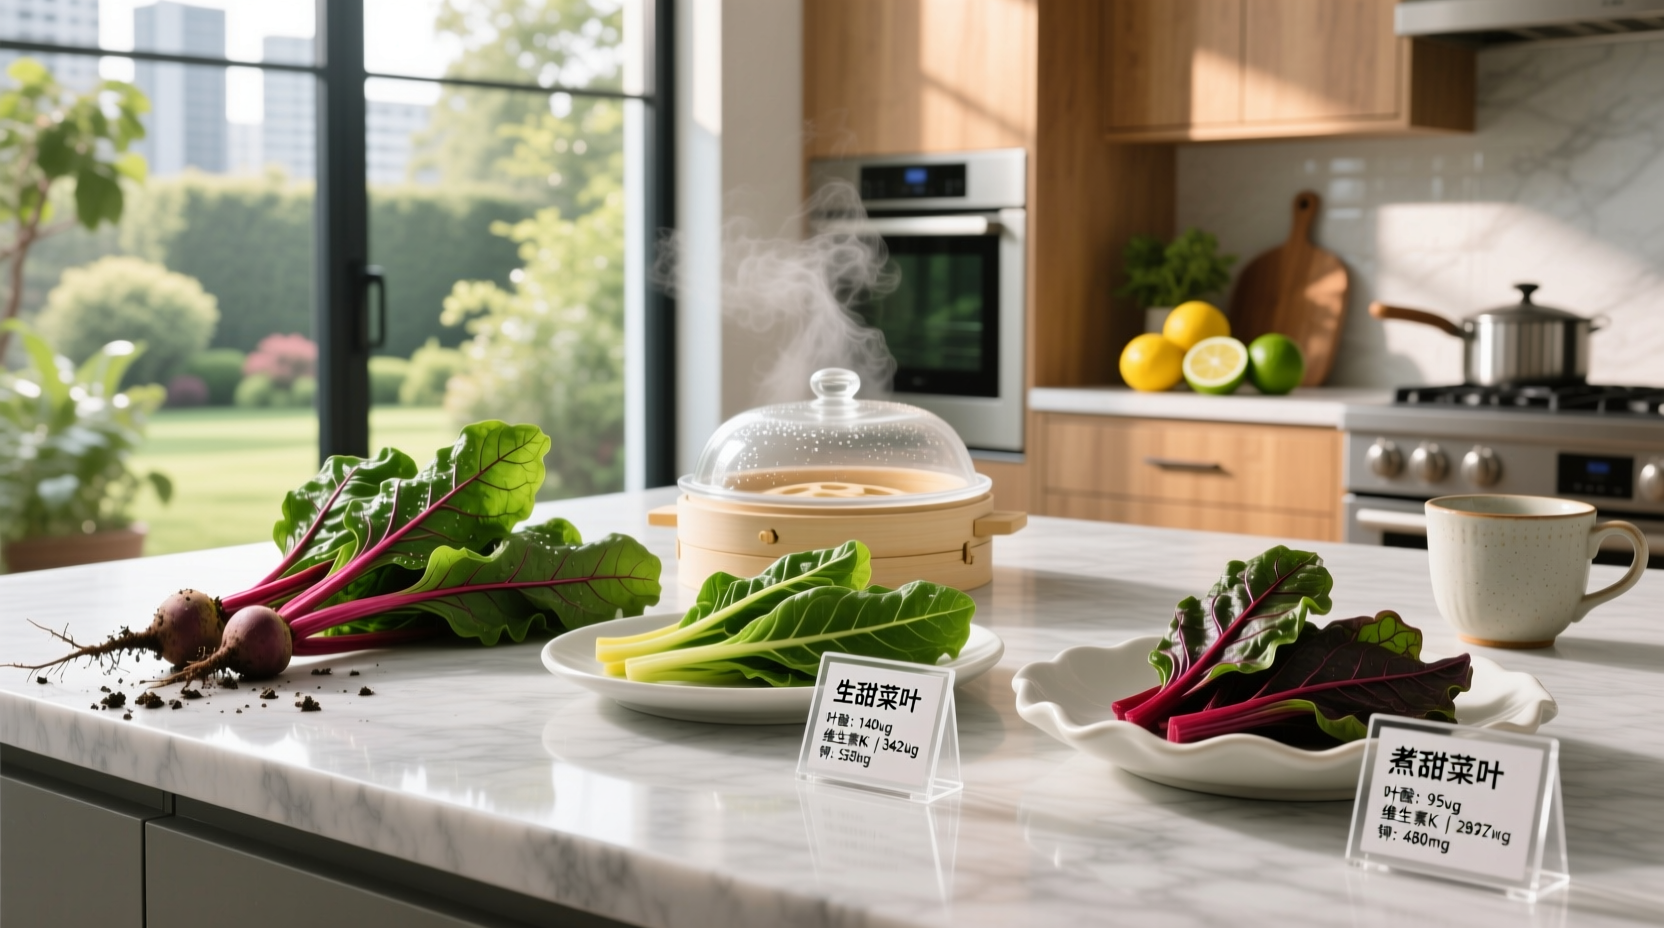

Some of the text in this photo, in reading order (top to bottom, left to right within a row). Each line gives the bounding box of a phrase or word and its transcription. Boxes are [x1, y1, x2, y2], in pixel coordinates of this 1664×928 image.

[833, 679, 922, 713] 生甜菜叶
[882, 738, 919, 759] 342ug
[1388, 745, 1504, 790] 煮甜菜叶
